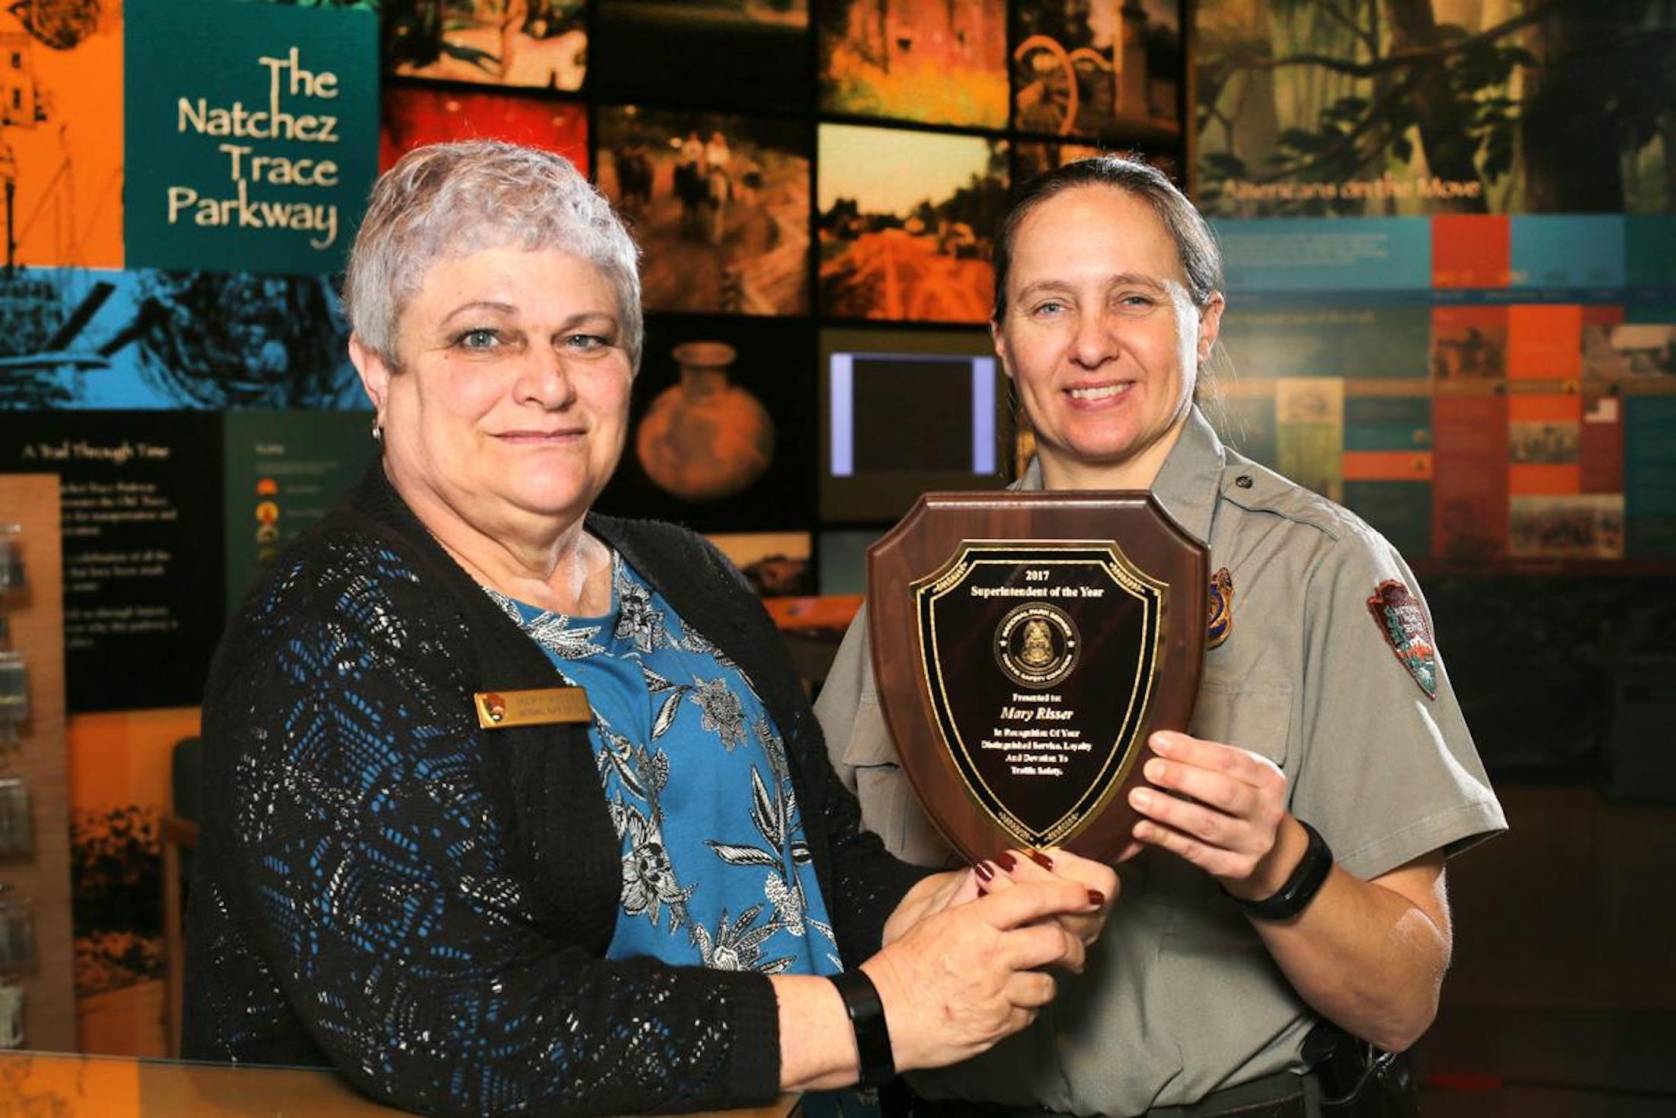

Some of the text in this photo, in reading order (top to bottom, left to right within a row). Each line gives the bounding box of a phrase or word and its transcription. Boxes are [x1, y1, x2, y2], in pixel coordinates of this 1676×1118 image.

[259, 47, 339, 99] The
[177, 97, 339, 142] Natchez
[219, 144, 339, 186] Trace
[167, 179, 338, 250] Parkway
[23, 440, 170, 465] A Trail Through Time
[1025, 570, 1050, 581] 2017
[970, 586, 1104, 599] Superintendent of the Year
[1000, 707, 1074, 721] Mary Risser
